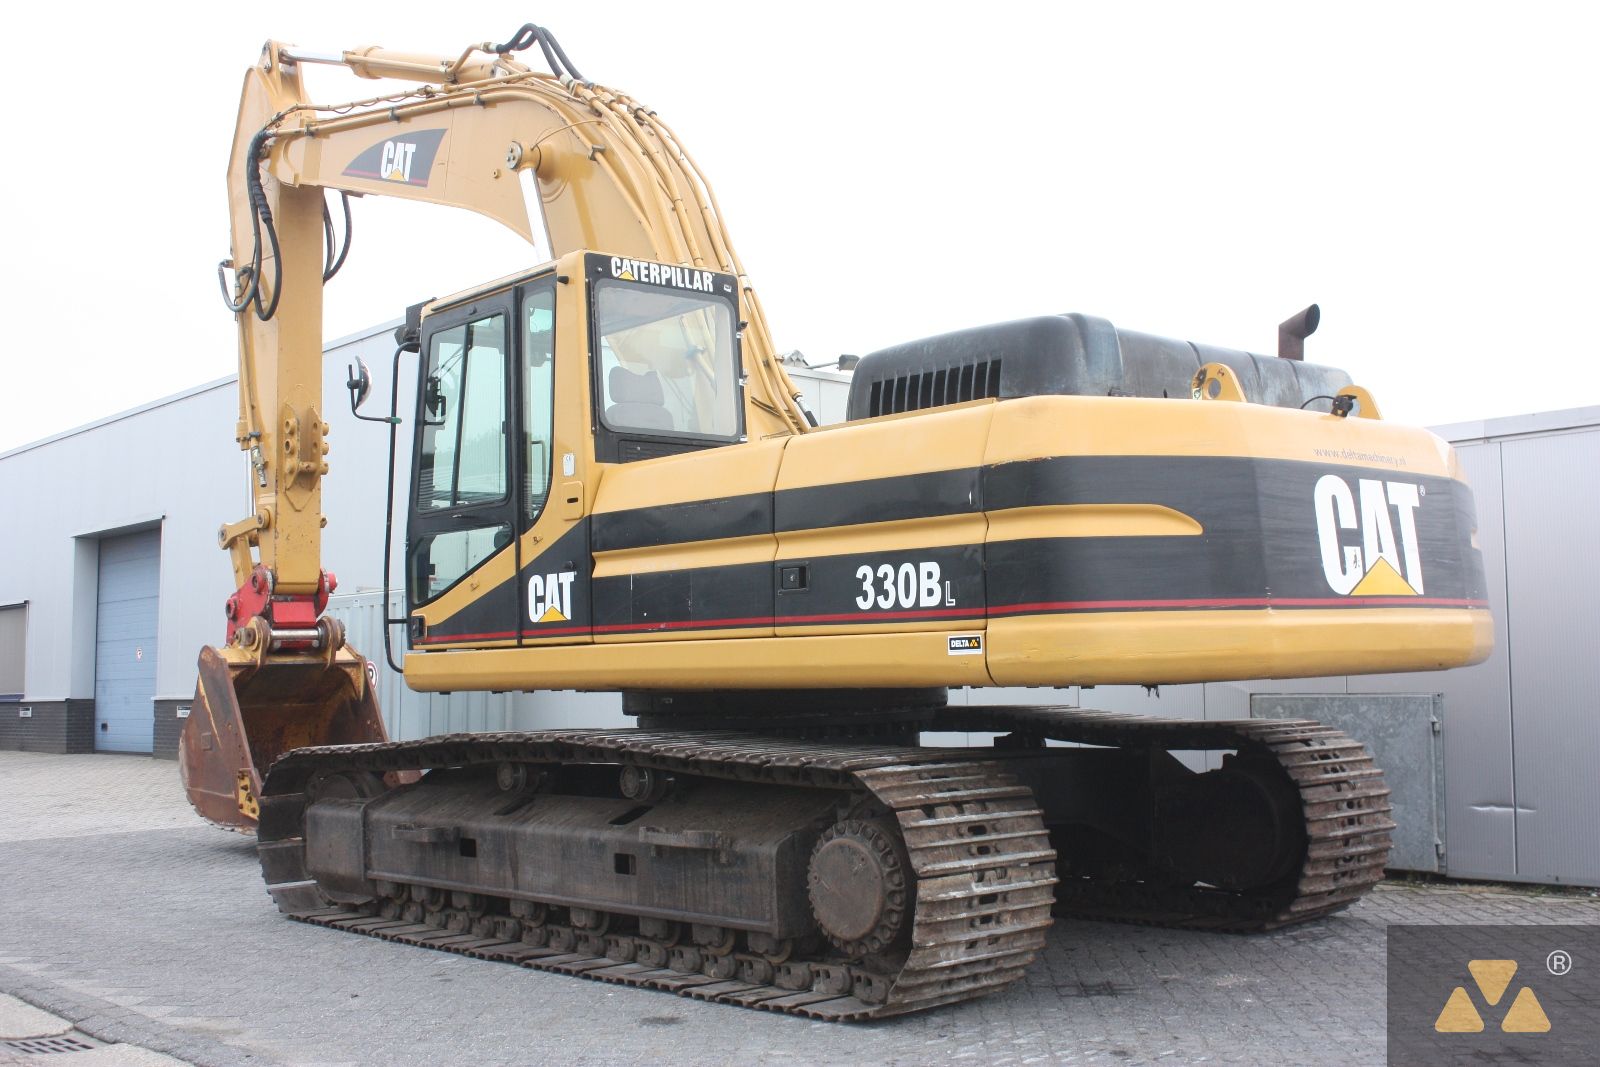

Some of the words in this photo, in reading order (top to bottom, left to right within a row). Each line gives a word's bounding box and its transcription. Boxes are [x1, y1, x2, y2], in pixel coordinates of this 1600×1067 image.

[380, 140, 417, 182] CAT
[610, 256, 715, 292] CATERPILLAR
[1313, 474, 1426, 596] CAT
[527, 571, 576, 623] CAT
[855, 561, 942, 610] 330B
[945, 580, 956, 606] L
[950, 639, 970, 648] DELTA
